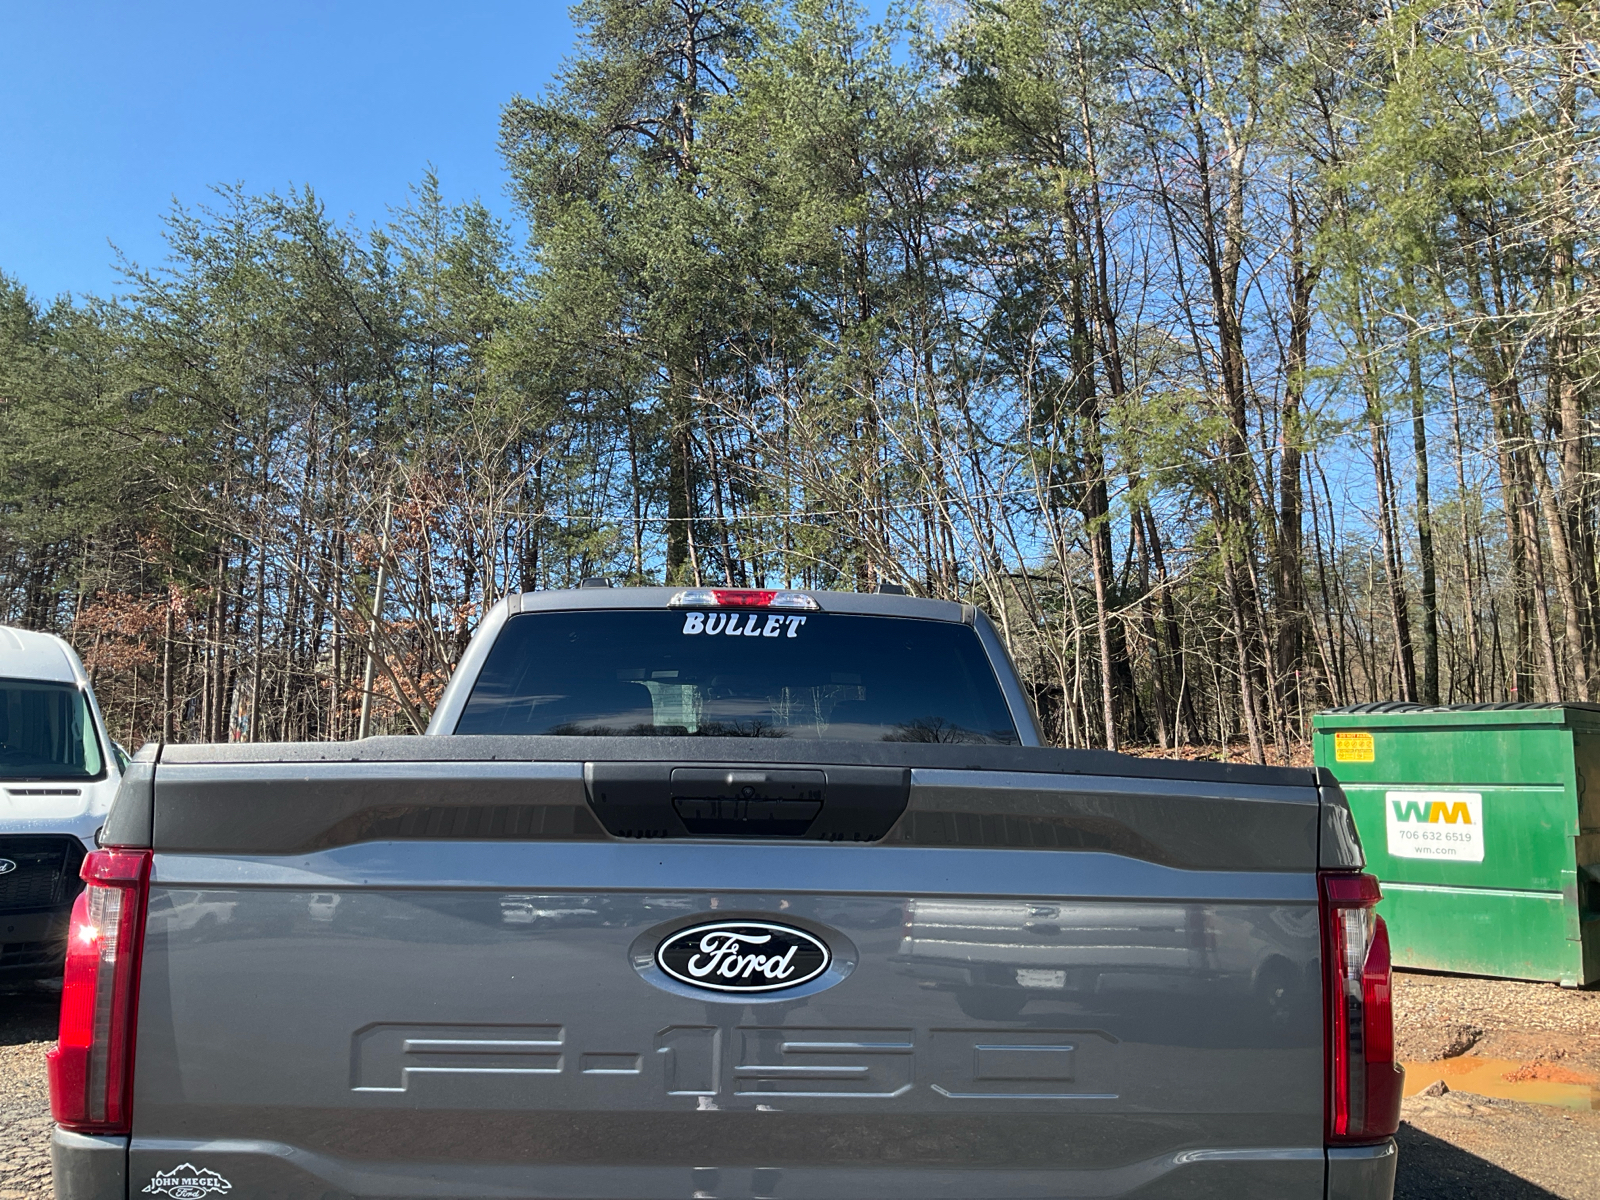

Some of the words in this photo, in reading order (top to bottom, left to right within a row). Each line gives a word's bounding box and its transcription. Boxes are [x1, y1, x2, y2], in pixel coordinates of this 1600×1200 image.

[682, 612, 807, 638] BULLET
[1392, 800, 1473, 825] WM
[1399, 830, 1420, 840] 706
[1422, 831, 1442, 841] 632
[1445, 832, 1472, 842] 6519
[1414, 846, 1457, 855] wm.com
[687, 931, 799, 979] Ford
[349, 1022, 1121, 1100] F-150
[151, 1178, 179, 1189] JOHN
[181, 1178, 220, 1187] MEGEL
[175, 1187, 200, 1198] Ford
